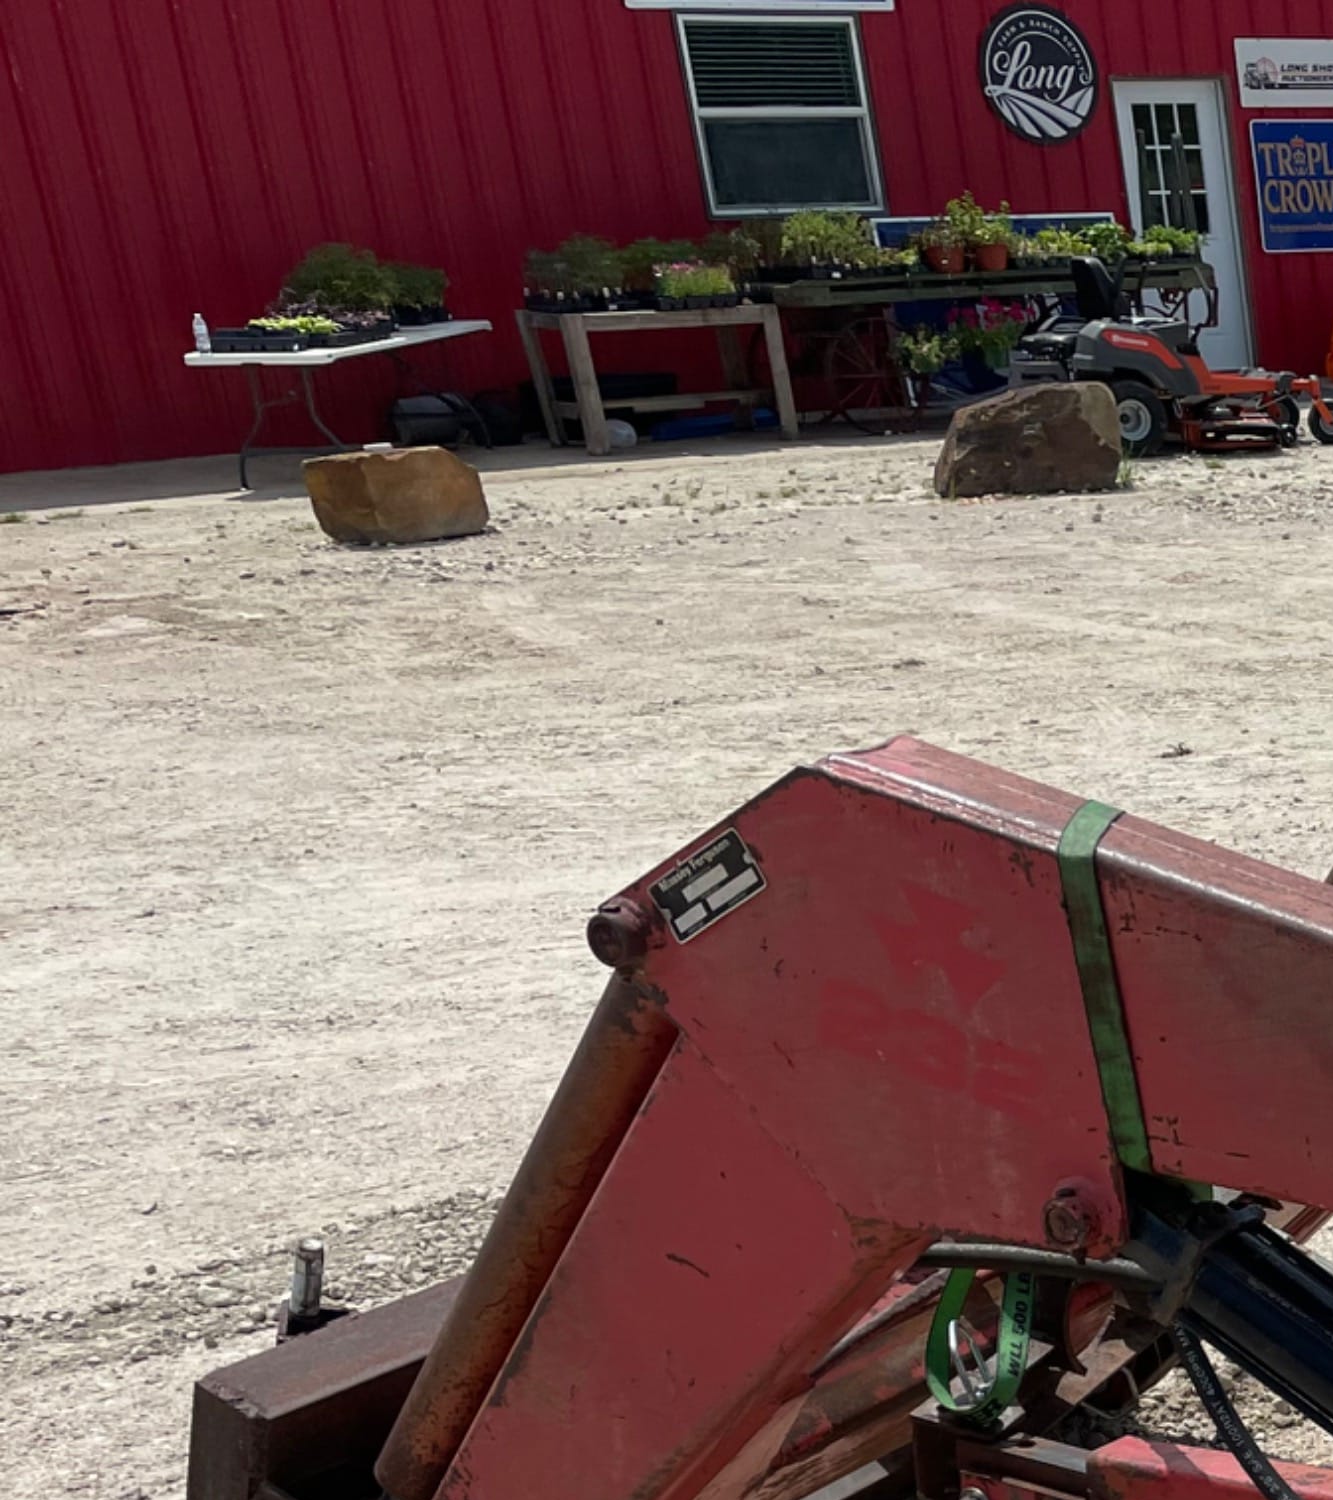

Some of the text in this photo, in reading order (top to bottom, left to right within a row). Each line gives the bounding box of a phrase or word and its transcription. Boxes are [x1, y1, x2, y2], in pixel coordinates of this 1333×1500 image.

[1028, 18, 1061, 35] RANCH
[1061, 34, 1085, 73] SUPPLY
[992, 41, 1077, 104] Long
[1280, 63, 1309, 73] LONG
[1011, 1300, 1029, 1336] 500
[1007, 1341, 1024, 1379] WLL
